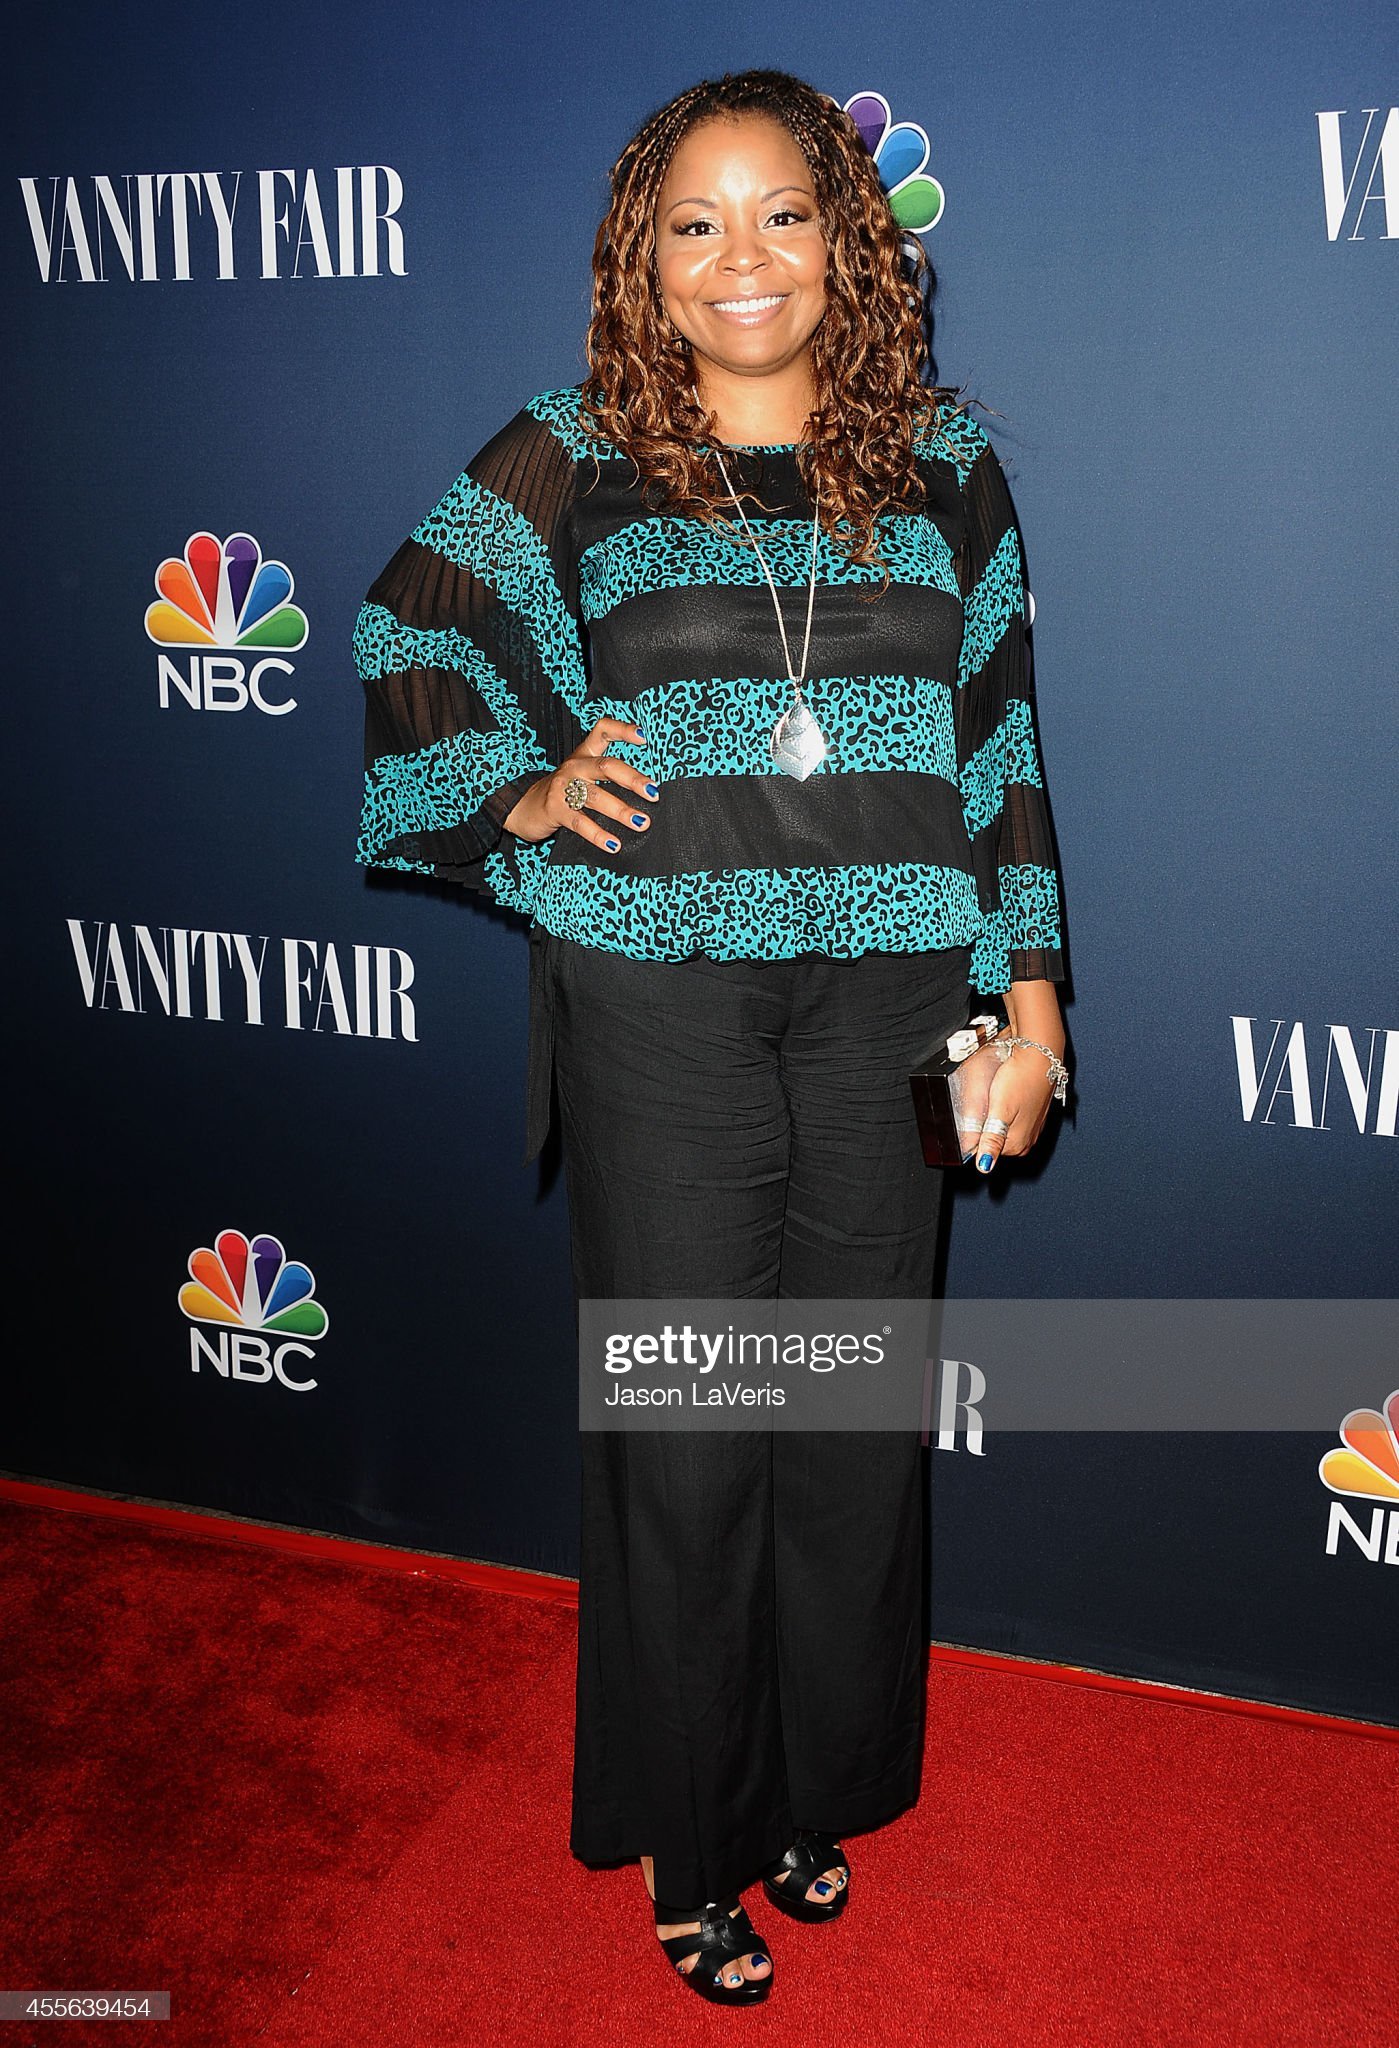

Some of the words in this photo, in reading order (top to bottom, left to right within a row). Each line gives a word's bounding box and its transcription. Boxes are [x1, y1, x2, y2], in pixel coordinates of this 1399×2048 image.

[17, 170, 243, 283] VANITY
[256, 164, 410, 280] FAIR
[157, 653, 298, 716] NBC
[66, 918, 270, 1026] VANITY
[281, 937, 420, 1043] FAIR
[1229, 1015, 1399, 1138] VANI
[189, 1327, 319, 1392] NBC
